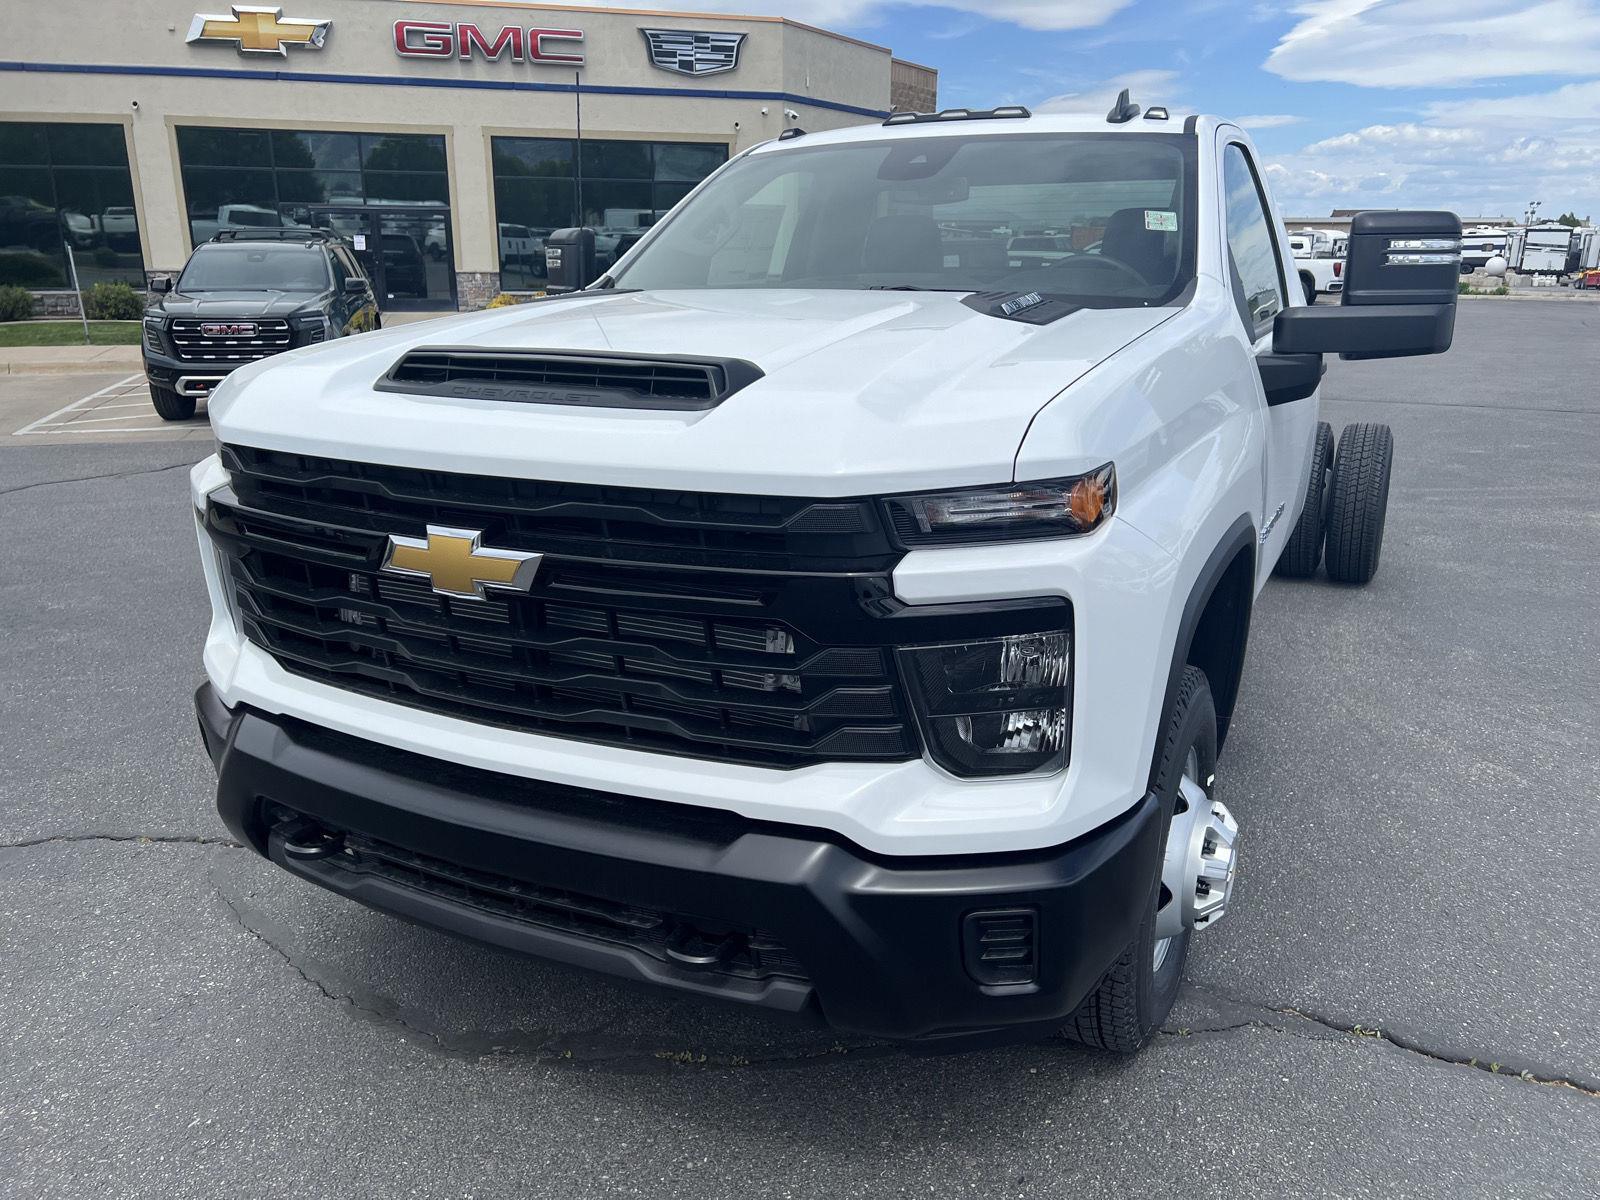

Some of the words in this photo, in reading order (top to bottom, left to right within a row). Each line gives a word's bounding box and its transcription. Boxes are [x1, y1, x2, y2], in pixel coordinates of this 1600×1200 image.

[393, 19, 585, 66] GMC
[203, 324, 256, 336] GMC
[452, 385, 601, 402] CHEVROLET
